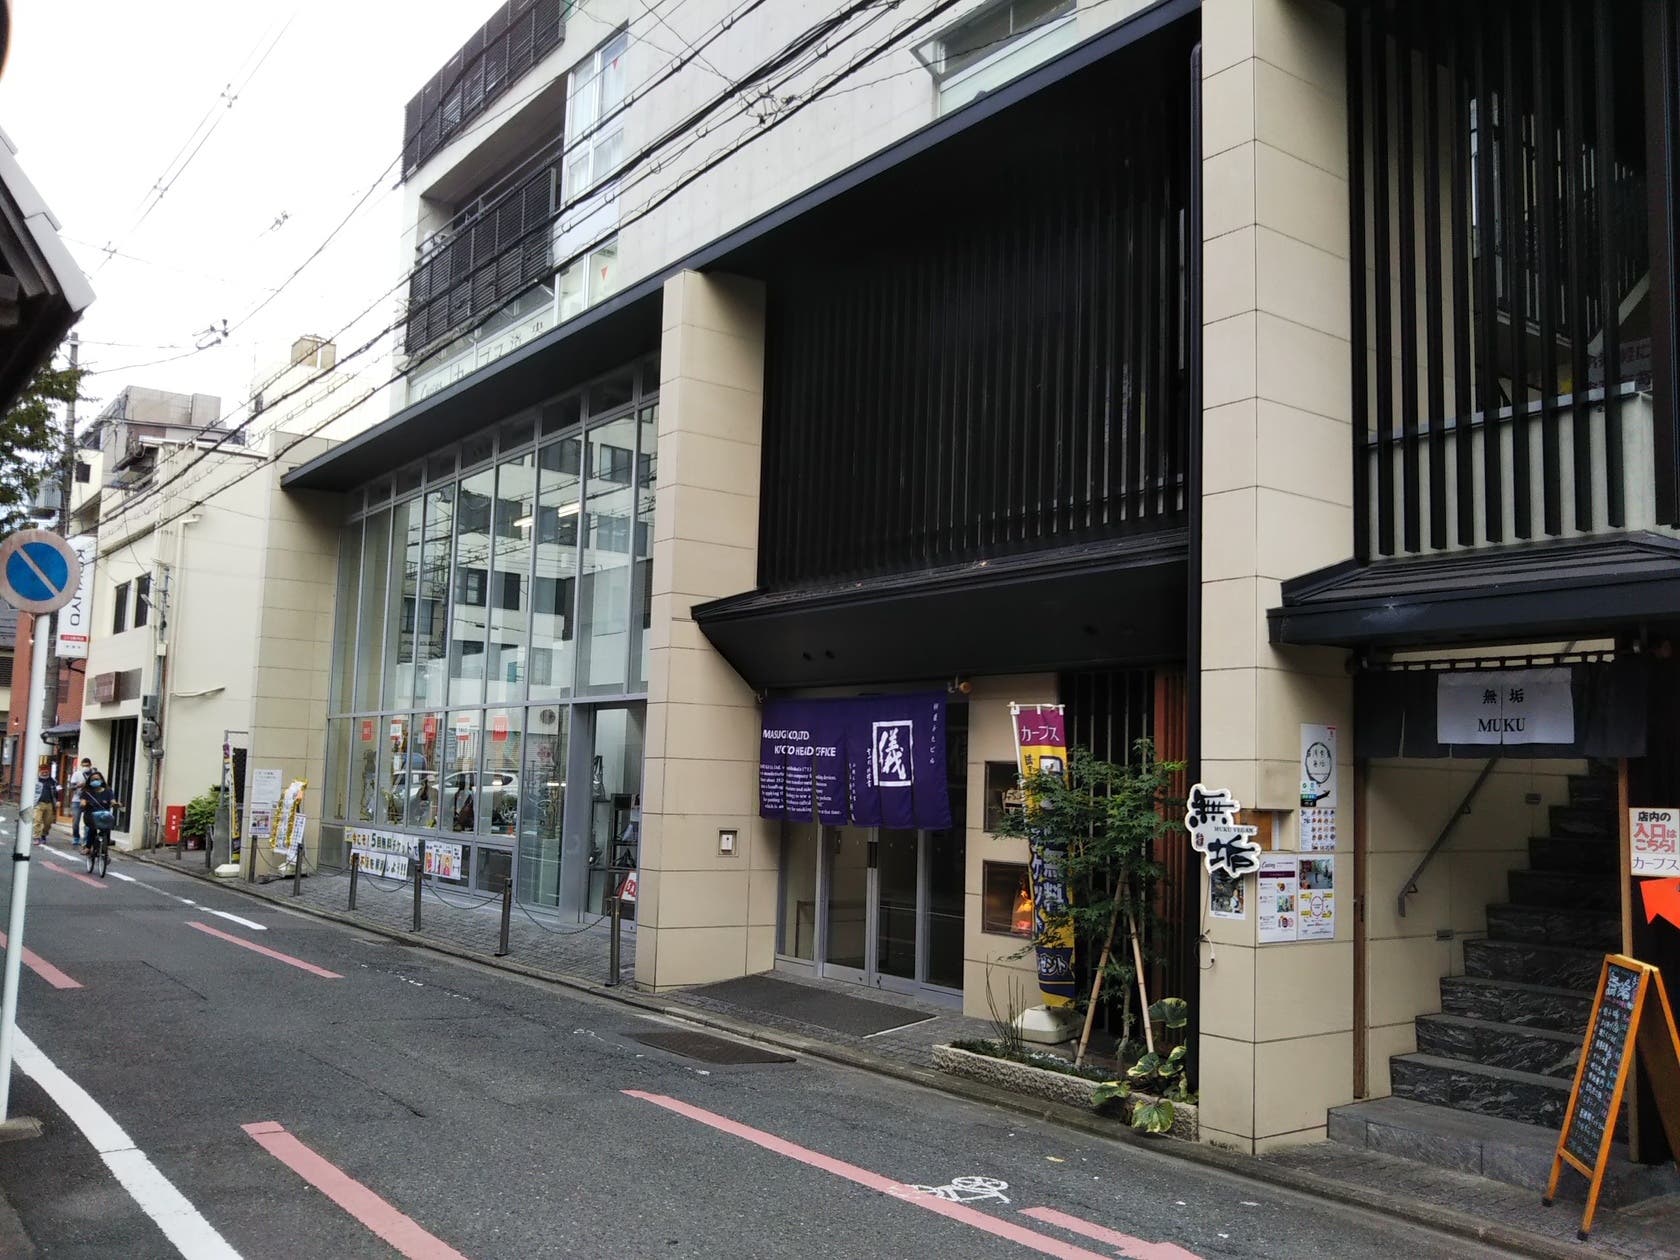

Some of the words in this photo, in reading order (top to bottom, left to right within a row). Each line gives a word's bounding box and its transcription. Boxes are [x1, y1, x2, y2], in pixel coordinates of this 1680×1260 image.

[1482, 688, 1525, 704] 無垢
[1477, 718, 1526, 732] MUKU
[1637, 811, 1672, 823] 店内の
[1633, 823, 1678, 840] 入口は
